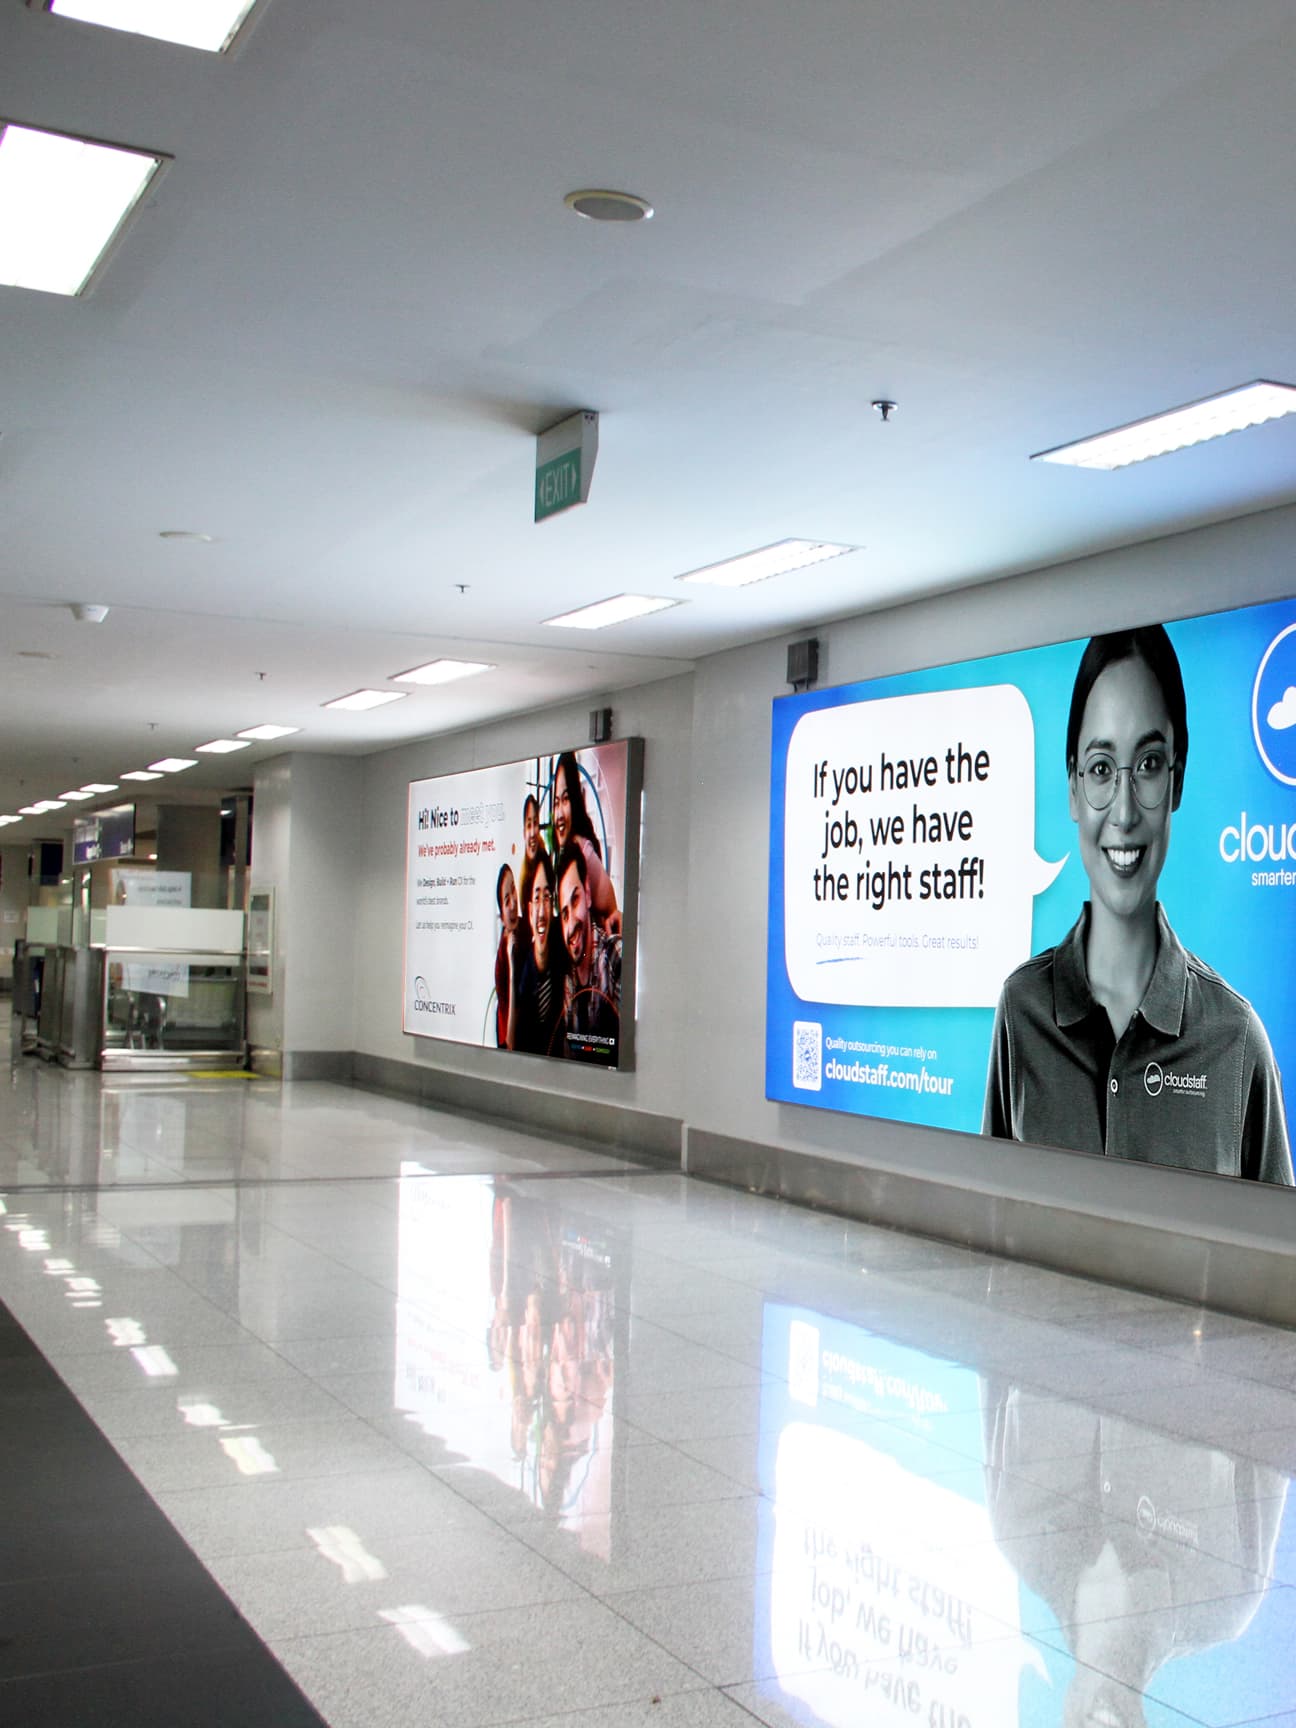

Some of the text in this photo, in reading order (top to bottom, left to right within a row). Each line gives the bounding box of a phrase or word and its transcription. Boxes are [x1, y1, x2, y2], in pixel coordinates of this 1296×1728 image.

[545, 463, 570, 506] EXIT
[814, 742, 990, 806] If you have the
[418, 808, 429, 830] Hi!
[431, 806, 448, 829] Nice
[450, 808, 459, 826] to
[822, 804, 973, 859] job, we have
[435, 841, 458, 859] probably
[460, 838, 481, 855] already
[814, 857, 984, 910] the right staff!
[1252, 868, 1296, 886] smarter
[816, 932, 842, 950] Quality
[863, 933, 897, 948] Powerful
[922, 934, 945, 949] Great
[947, 934, 979, 950] results!
[415, 1000, 456, 1015] CONCENTRIX
[825, 1037, 937, 1061] Quality outsourcing you can rely on
[825, 1058, 954, 1095] cloudstaff.com/tour
[1164, 1072, 1207, 1088] cloudstaff
